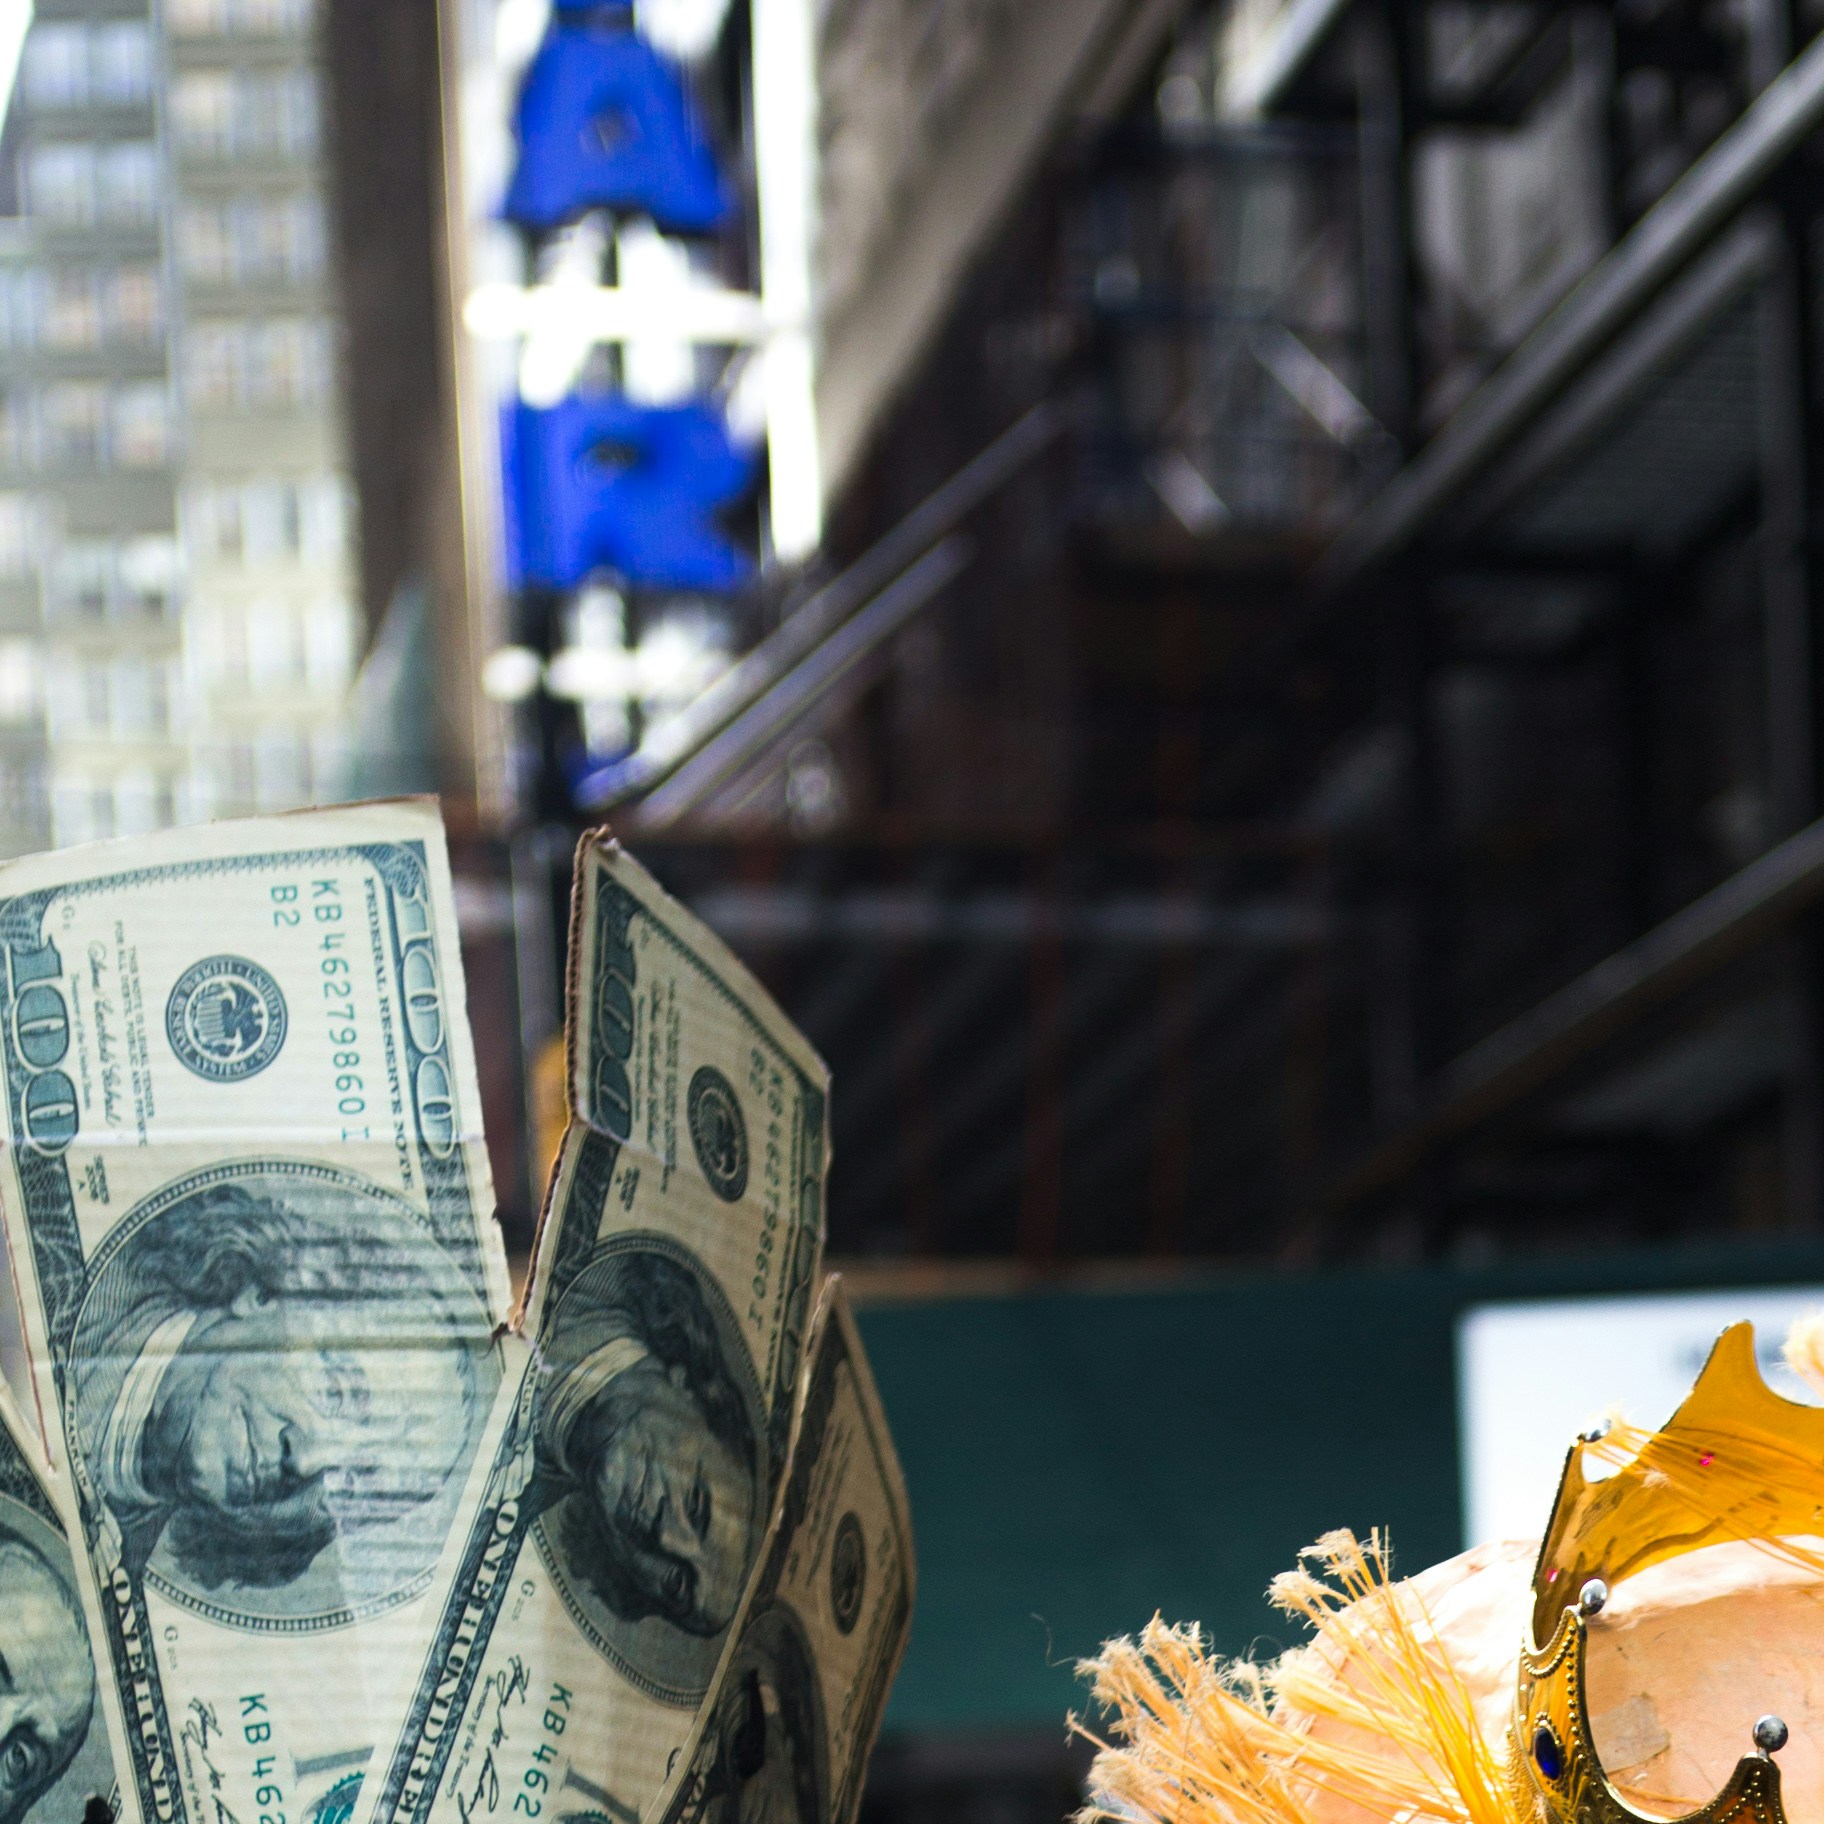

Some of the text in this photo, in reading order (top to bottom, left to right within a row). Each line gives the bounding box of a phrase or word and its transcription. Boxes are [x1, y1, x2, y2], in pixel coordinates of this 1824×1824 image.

[269, 882, 302, 929] B2
[310, 877, 344, 924] KB
[4, 934, 83, 1160] 100
[318, 932, 366, 1117] 46279860
[389, 882, 459, 1161] 100
[597, 918, 637, 1140] 100
[63, 1398, 91, 1490] FRANKLIN
[469, 1498, 523, 1598] ONE
[107, 1565, 149, 1678] ONE
[238, 1690, 272, 1746] KB
[538, 1680, 579, 1737] KB
